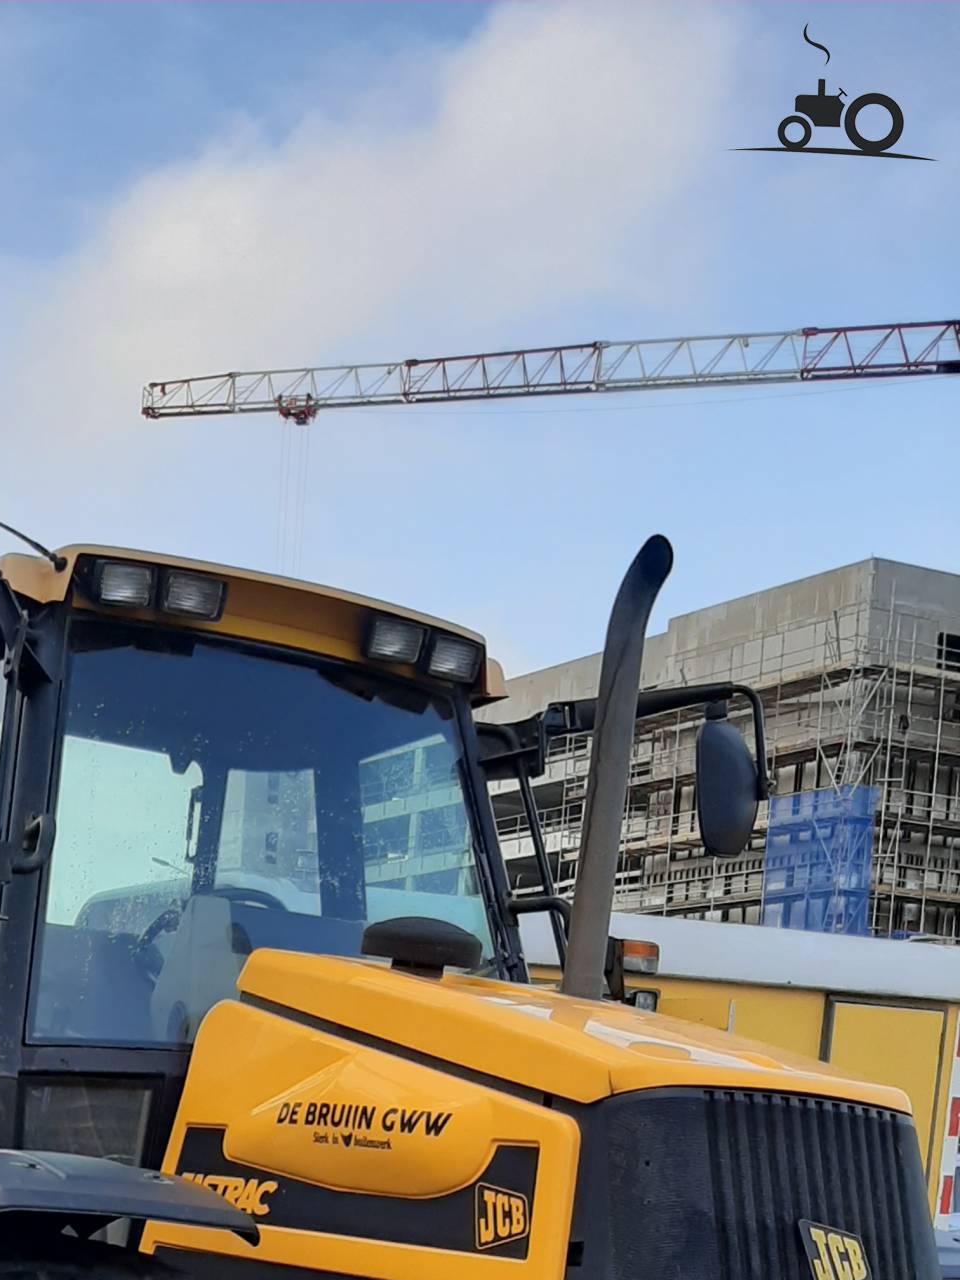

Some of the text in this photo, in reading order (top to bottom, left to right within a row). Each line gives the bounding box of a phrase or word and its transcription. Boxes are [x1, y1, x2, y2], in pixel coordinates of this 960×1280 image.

[276, 1102, 302, 1125] DE
[381, 1108, 453, 1137] GWW
[479, 1190, 525, 1244] JCB
